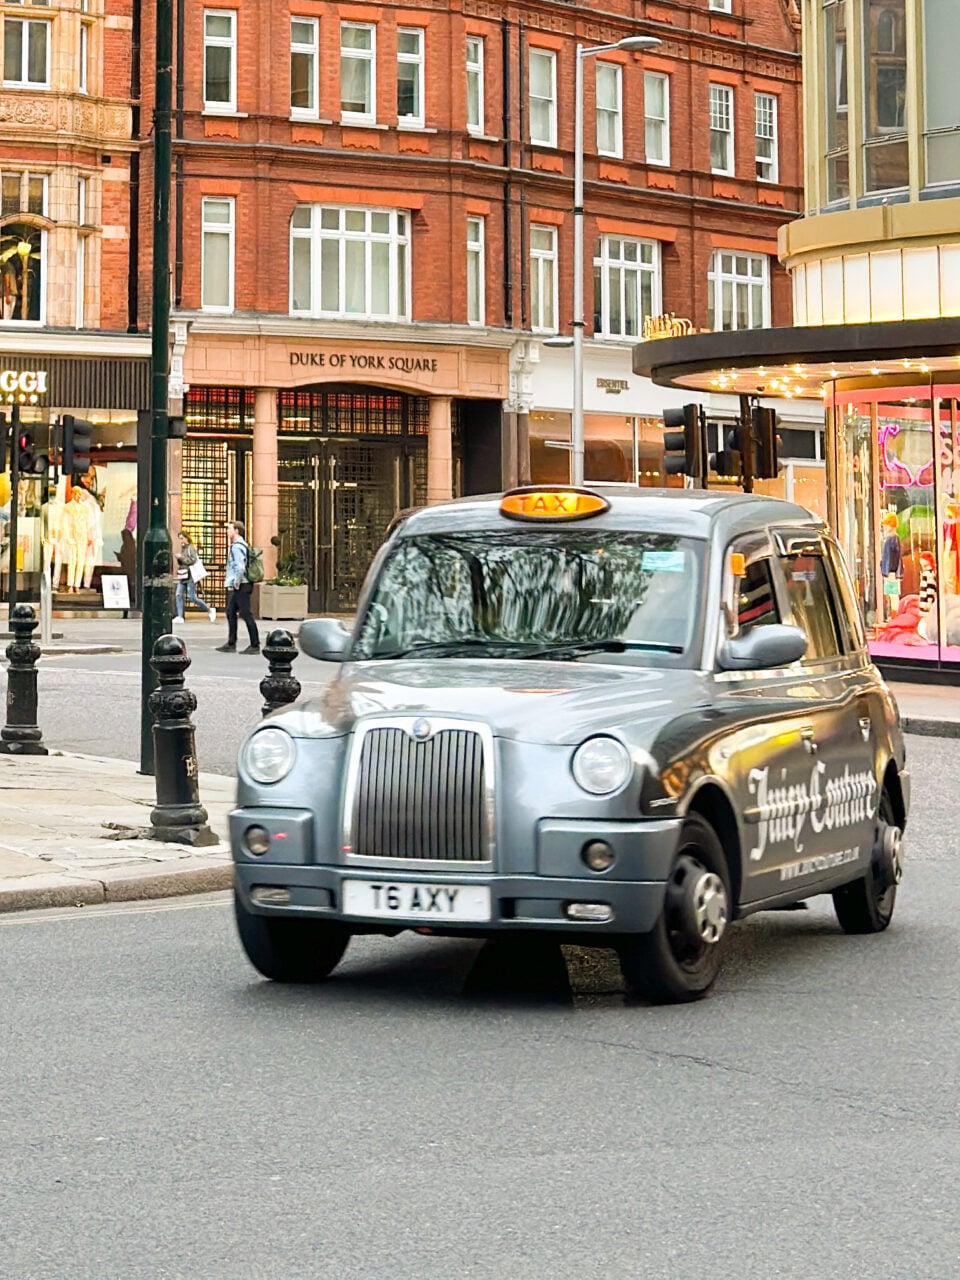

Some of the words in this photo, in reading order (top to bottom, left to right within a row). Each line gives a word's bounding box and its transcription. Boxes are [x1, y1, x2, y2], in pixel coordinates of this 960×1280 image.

[290, 352, 325, 366] DUKE
[329, 354, 346, 367] OF
[350, 355, 385, 369] YORK
[389, 357, 438, 373] SQUARE
[519, 495, 581, 513] TAXI
[370, 885, 401, 910] T6
[409, 887, 460, 913] AXY
